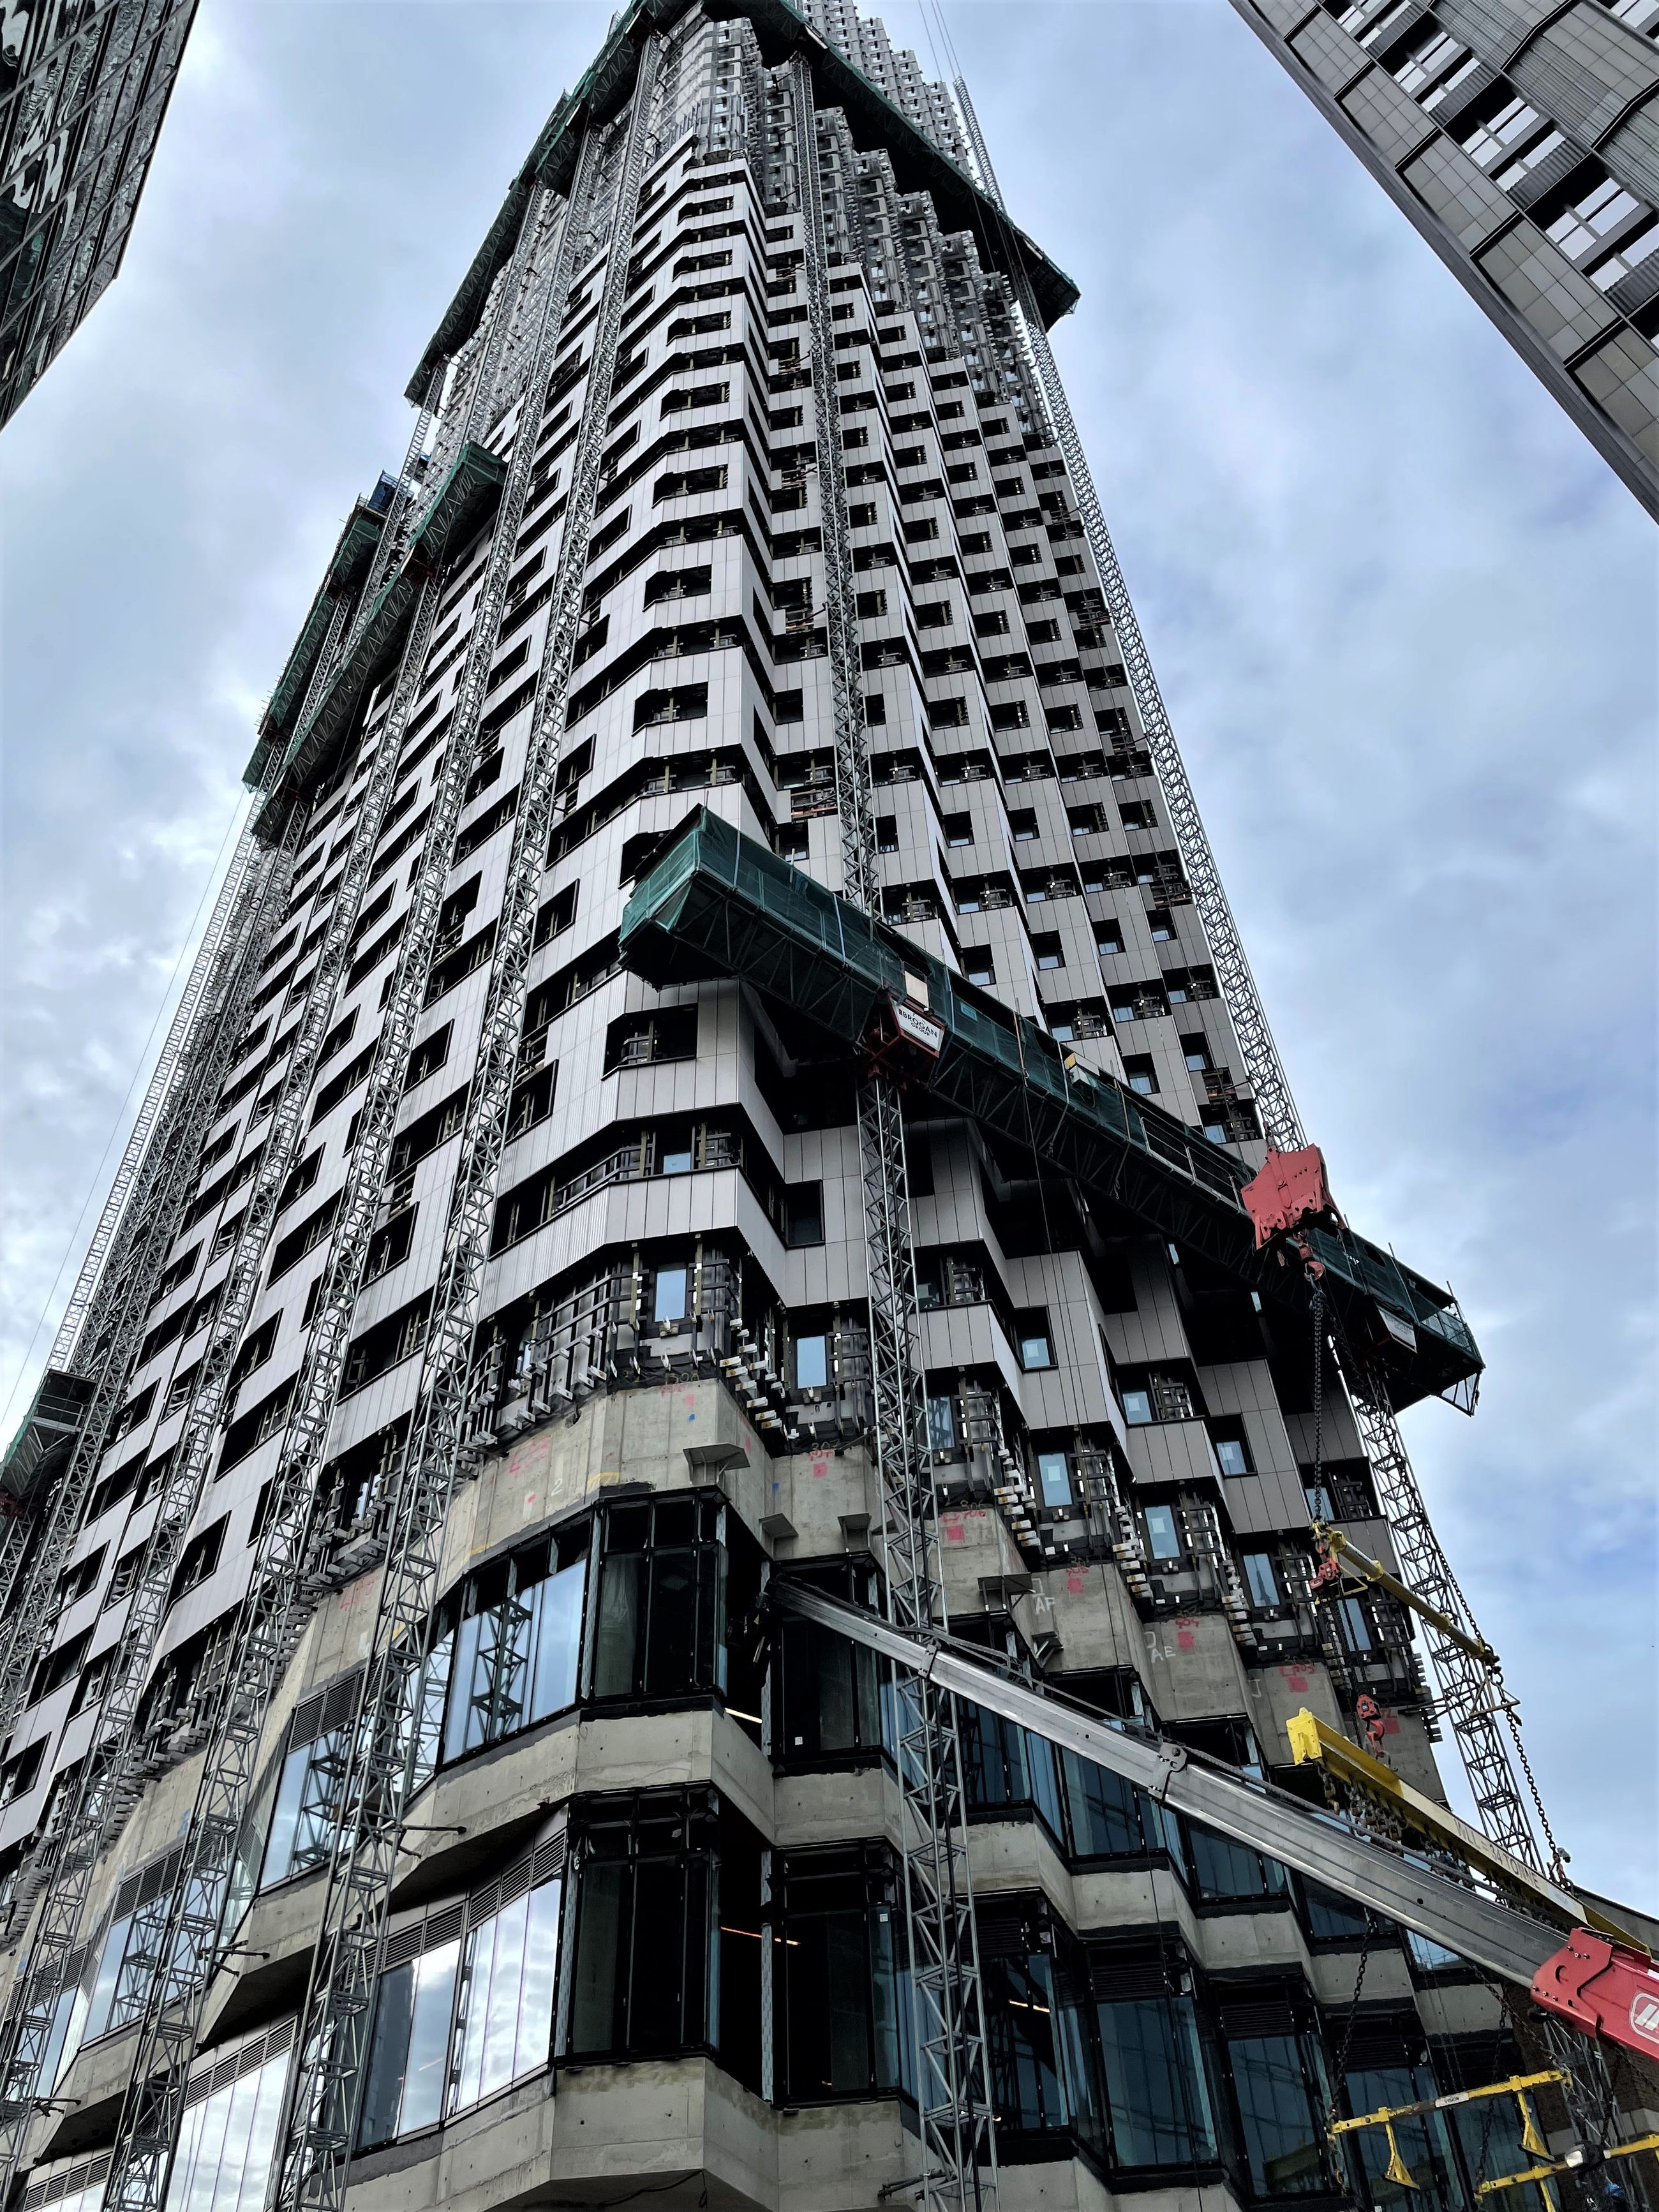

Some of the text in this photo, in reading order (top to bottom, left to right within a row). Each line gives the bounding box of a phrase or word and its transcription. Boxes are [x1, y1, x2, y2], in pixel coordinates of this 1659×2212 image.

[903, 1011, 937, 1037] BROGAN
[911, 1022, 930, 1035] GROUP
[551, 1478, 563, 1496] 2
[1151, 1645, 1176, 1664] AE
[1454, 1818, 1481, 1850] WLL
